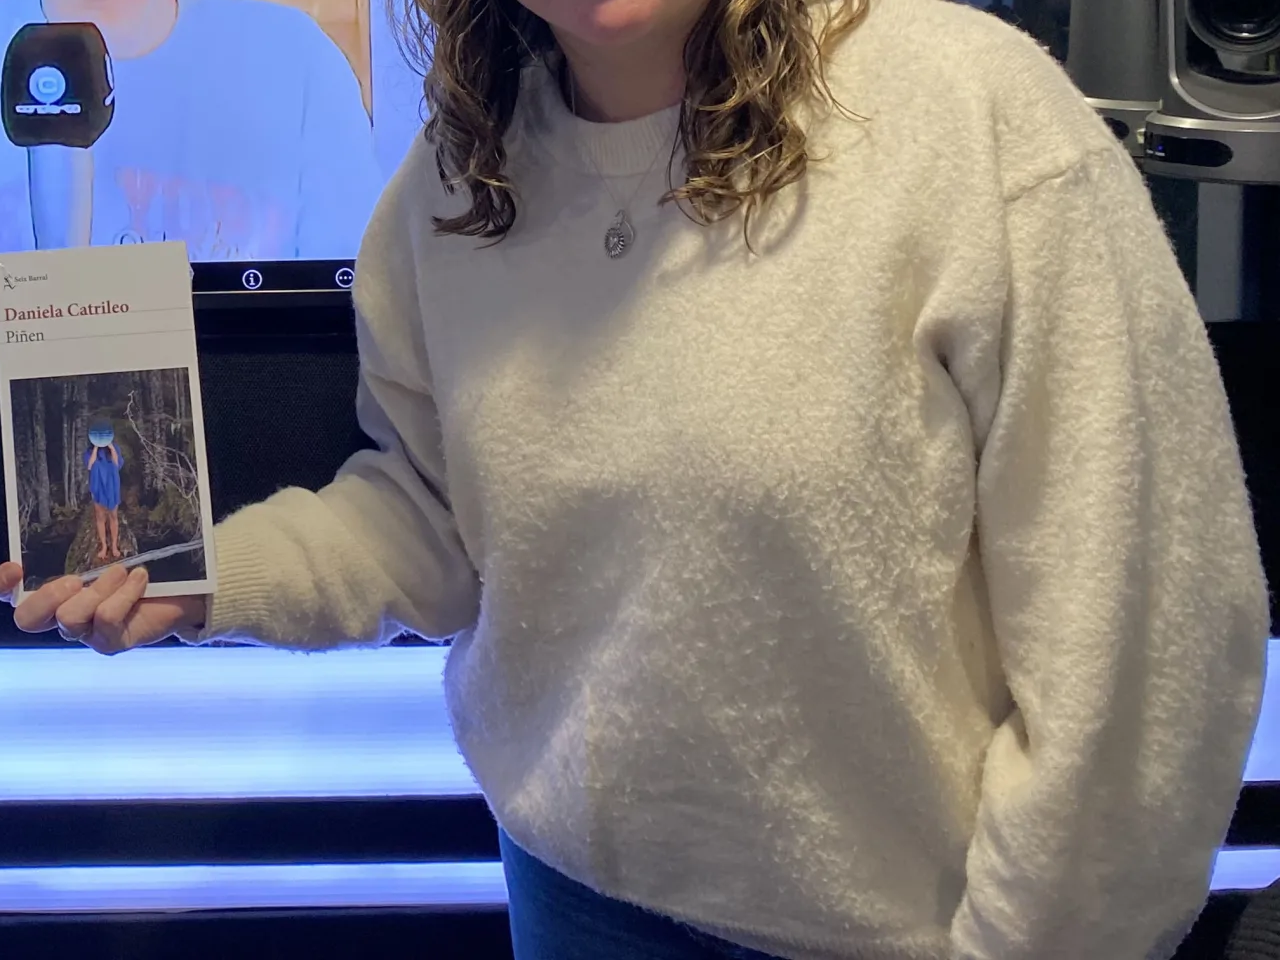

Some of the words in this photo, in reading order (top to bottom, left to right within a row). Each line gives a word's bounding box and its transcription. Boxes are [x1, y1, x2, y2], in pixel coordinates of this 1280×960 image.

[4, 304, 63, 321] Daniela
[67, 300, 130, 317] Catrileo
[6, 330, 45, 343] Piñen
